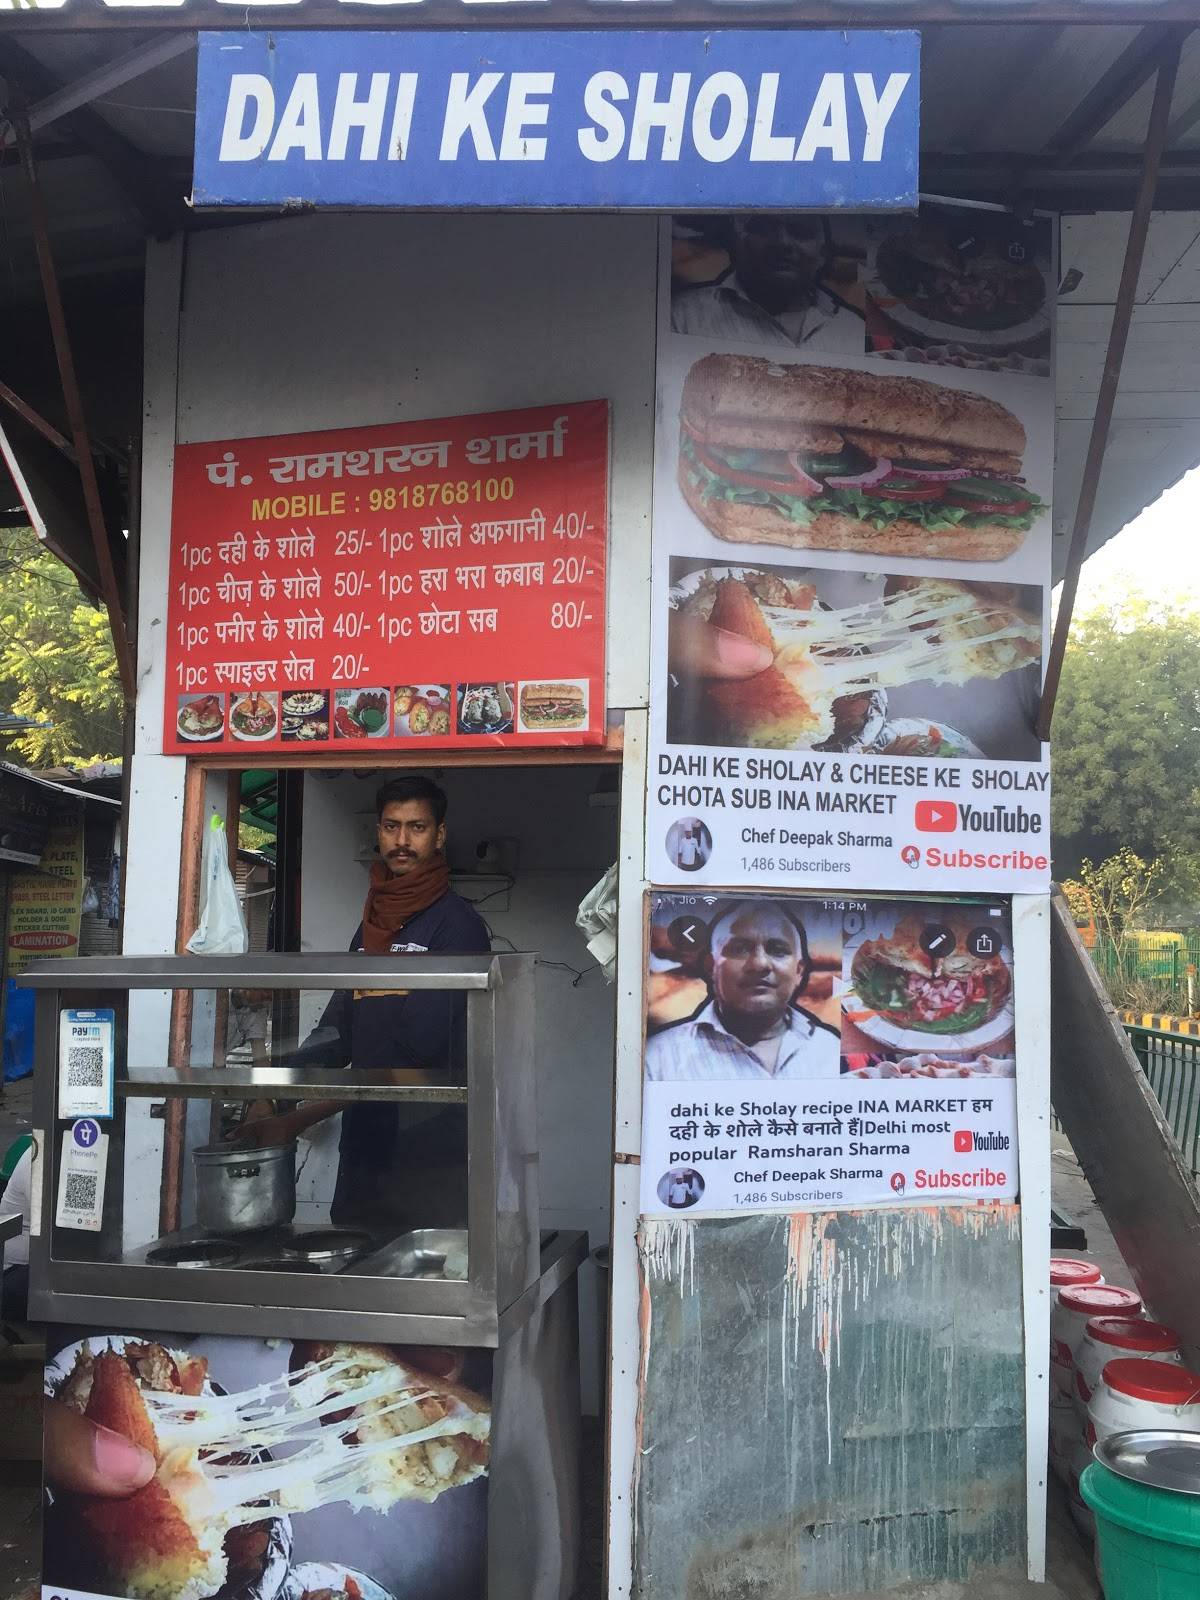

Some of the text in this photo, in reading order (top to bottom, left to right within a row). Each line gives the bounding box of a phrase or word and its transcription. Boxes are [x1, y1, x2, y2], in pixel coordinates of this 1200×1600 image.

[218, 70, 911, 163] DAHI KE SHOLAY
[206, 451, 253, 487] पं.
[465, 416, 569, 465] शर्मा
[252, 476, 514, 521] MOBILE : 9818768100
[180, 508, 594, 571] 1pc दही के शोले 25/- 1pc शोले अफगानी 40/-
[178, 582, 211, 611] 1pc
[258, 570, 276, 600] के
[282, 567, 322, 600] शोले
[334, 570, 372, 597] 50/-
[378, 569, 413, 601] 1pc
[419, 568, 448, 595] हरा
[455, 565, 486, 590] भरा
[493, 561, 545, 587] कबाब
[552, 555, 594, 585] 20/-
[177, 600, 593, 651] 1pc पनीर के शोले 40/- 1pc छोटा सब 80/-
[176, 650, 370, 691] 1pc स्पाइडर रोल 20/-
[658, 754, 1050, 791] DAHI KE SHOLAY & CHEESE KE SHOLAY
[657, 784, 897, 815] CHOTA SUB INA MARKET
[958, 803, 1041, 834] YouTube
[741, 827, 893, 848] Chef Deepak Sharma
[741, 857, 851, 873] 1,486 Subscribers
[926, 847, 1048, 870] Subscribe
[680, 896, 696, 905] Jio
[823, 901, 867, 912] 1:14 PM
[13, 935, 69, 946] LAMINATION
[670, 1099, 993, 1121] dahi ke Sholay recipe INA MARKET हम
[669, 1119, 699, 1140] दही
[703, 1119, 721, 1140] के
[725, 1119, 763, 1139] शोले
[767, 1118, 797, 1138] कैसे
[803, 1117, 842, 1137] बनाते
[911, 1119, 951, 1134] most
[973, 1130, 1010, 1152] YouTube
[669, 1142, 910, 1164] popular Ramsharan Sharma
[733, 1167, 883, 1186] Chef Deepak Sharma
[914, 1167, 1007, 1188] Subscribe
[734, 1190, 843, 1205] 1,486 Subscribers
